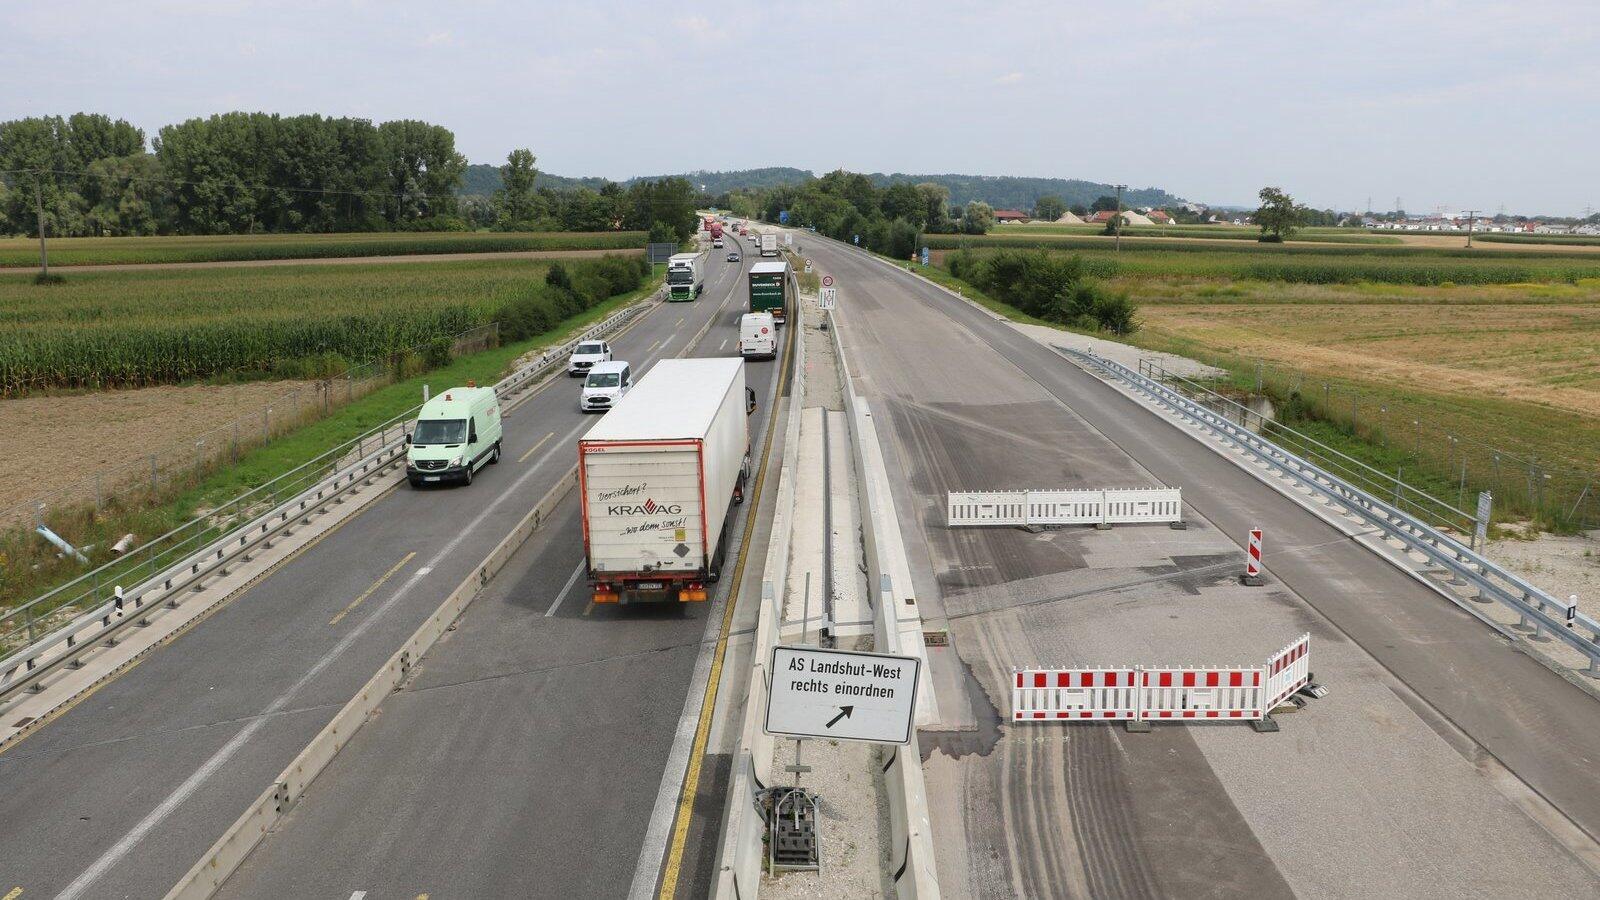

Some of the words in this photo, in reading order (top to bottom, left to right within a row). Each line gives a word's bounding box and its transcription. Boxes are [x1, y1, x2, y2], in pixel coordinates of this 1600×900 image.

[608, 503, 682, 515] KRAVAG
[640, 521, 660, 532] denn
[661, 517, 687, 528] sonst!
[789, 657, 805, 671] AS
[810, 659, 901, 679] Landshut-West
[791, 679, 828, 693] rechts
[835, 681, 894, 698] einordnen
